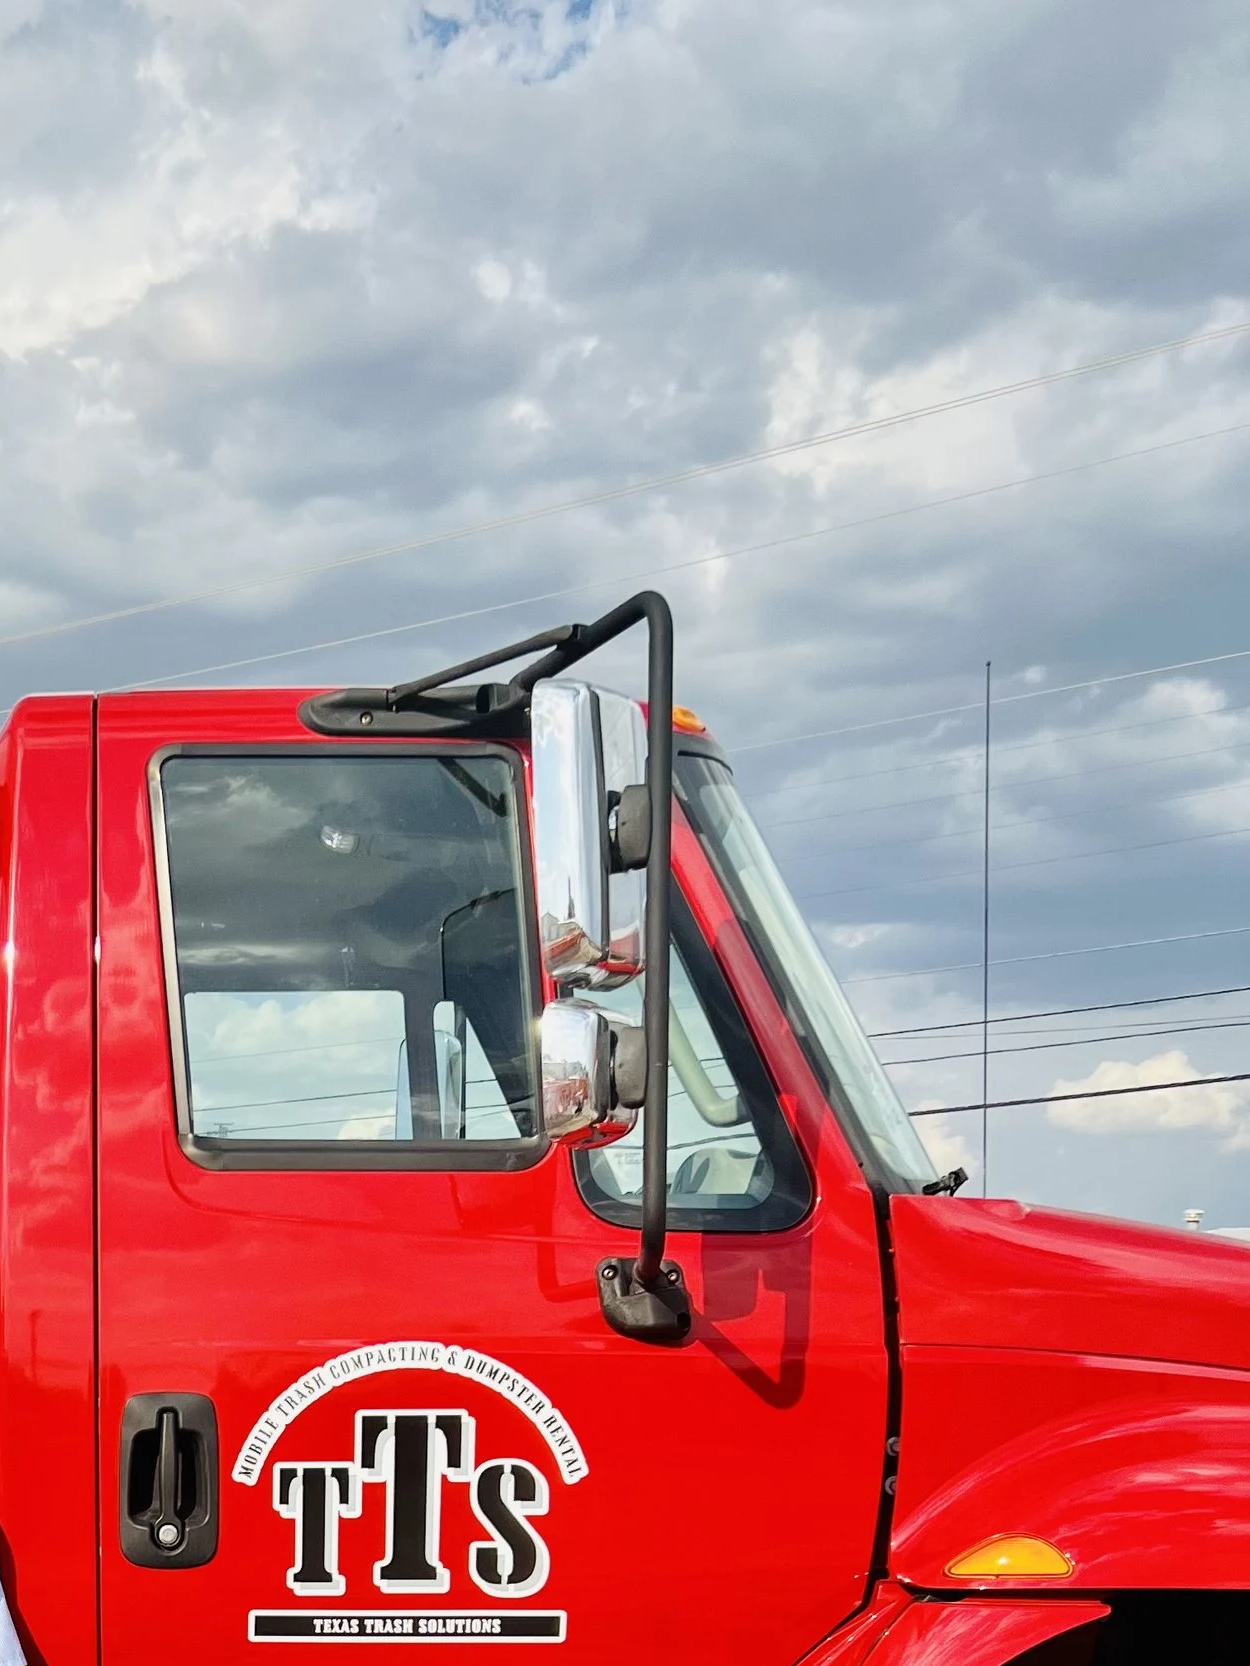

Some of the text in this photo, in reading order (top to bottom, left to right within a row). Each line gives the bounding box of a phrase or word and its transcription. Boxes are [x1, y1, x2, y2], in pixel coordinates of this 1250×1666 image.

[238, 1346, 583, 1479] MOBILE TRASH COMPACTING & DUMPSTER RENTAL
[276, 1412, 545, 1593] TTS
[313, 1618, 502, 1634] TEXAS TRASH SOLUTIONS
